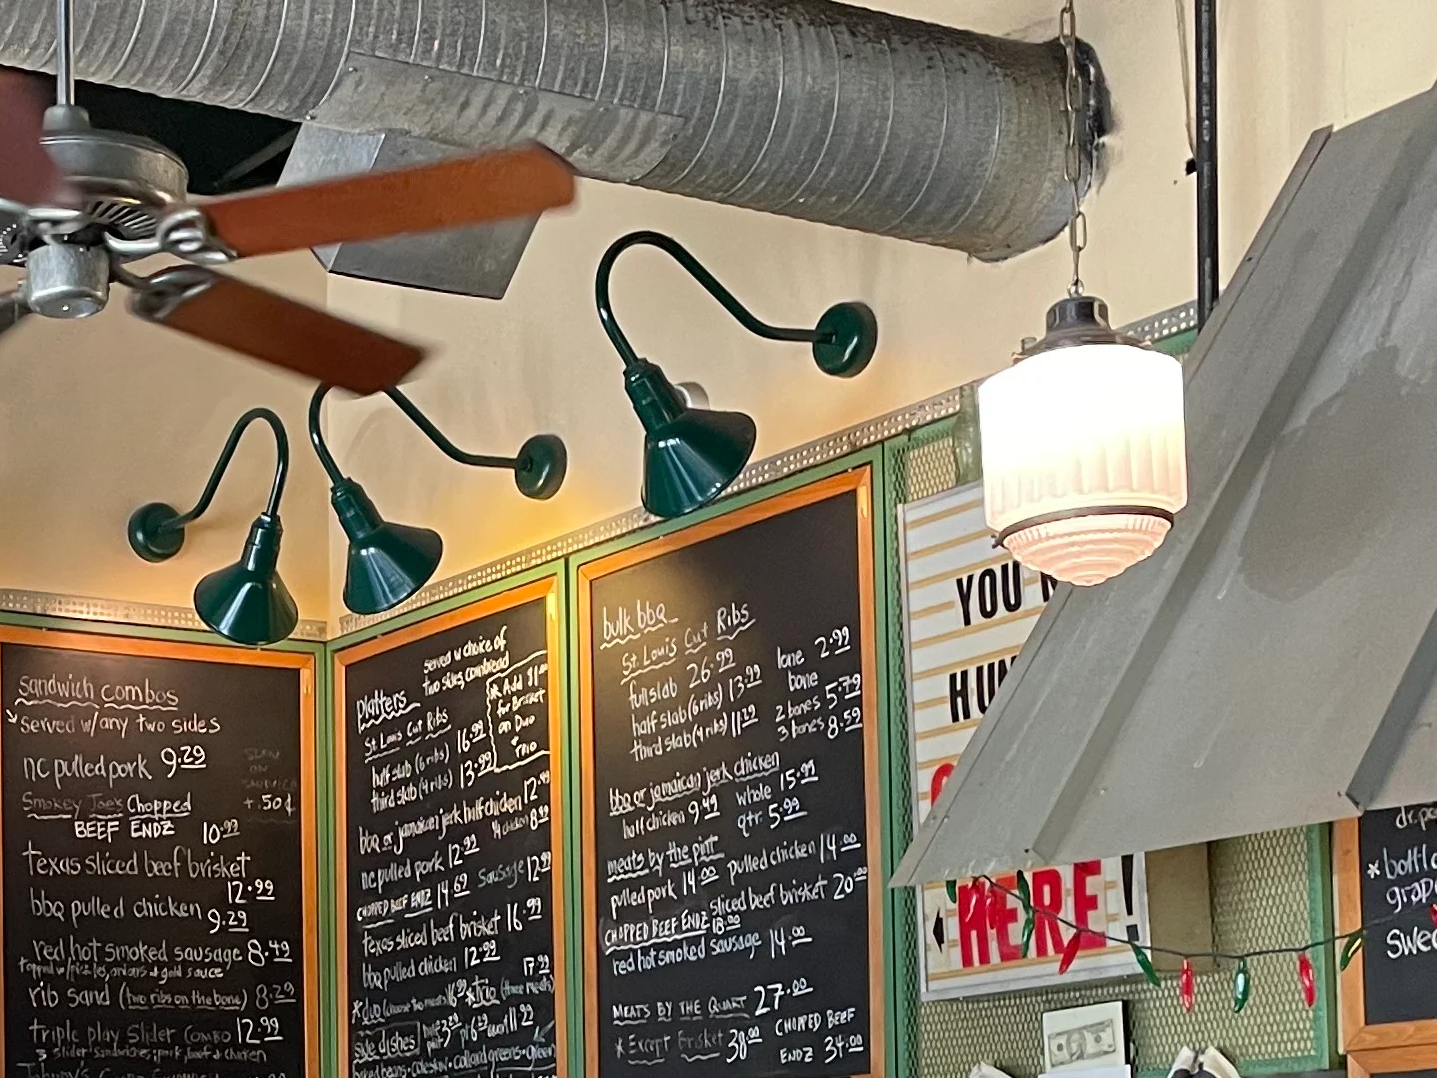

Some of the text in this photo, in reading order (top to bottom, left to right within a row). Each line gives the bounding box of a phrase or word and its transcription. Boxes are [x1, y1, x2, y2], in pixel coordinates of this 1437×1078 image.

[956, 560, 1024, 627] YOU
[603, 606, 634, 640] bulk
[100, 679, 179, 705] combos
[787, 671, 818, 691] bone
[137, 714, 220, 734] two sides
[109, 757, 151, 788] pork
[735, 784, 772, 806] whole
[74, 821, 175, 842] BEEF ENDZ
[86, 851, 138, 875] sliced
[187, 852, 250, 878] brisket
[728, 840, 816, 885] pulled chicken
[71, 894, 202, 927] pulled chicken
[460, 910, 501, 939] brisket
[105, 940, 167, 962] smoked
[174, 946, 242, 970] sausage
[710, 931, 762, 959] sausage
[418, 955, 457, 976] chicken
[613, 1001, 650, 1019] MEATS
